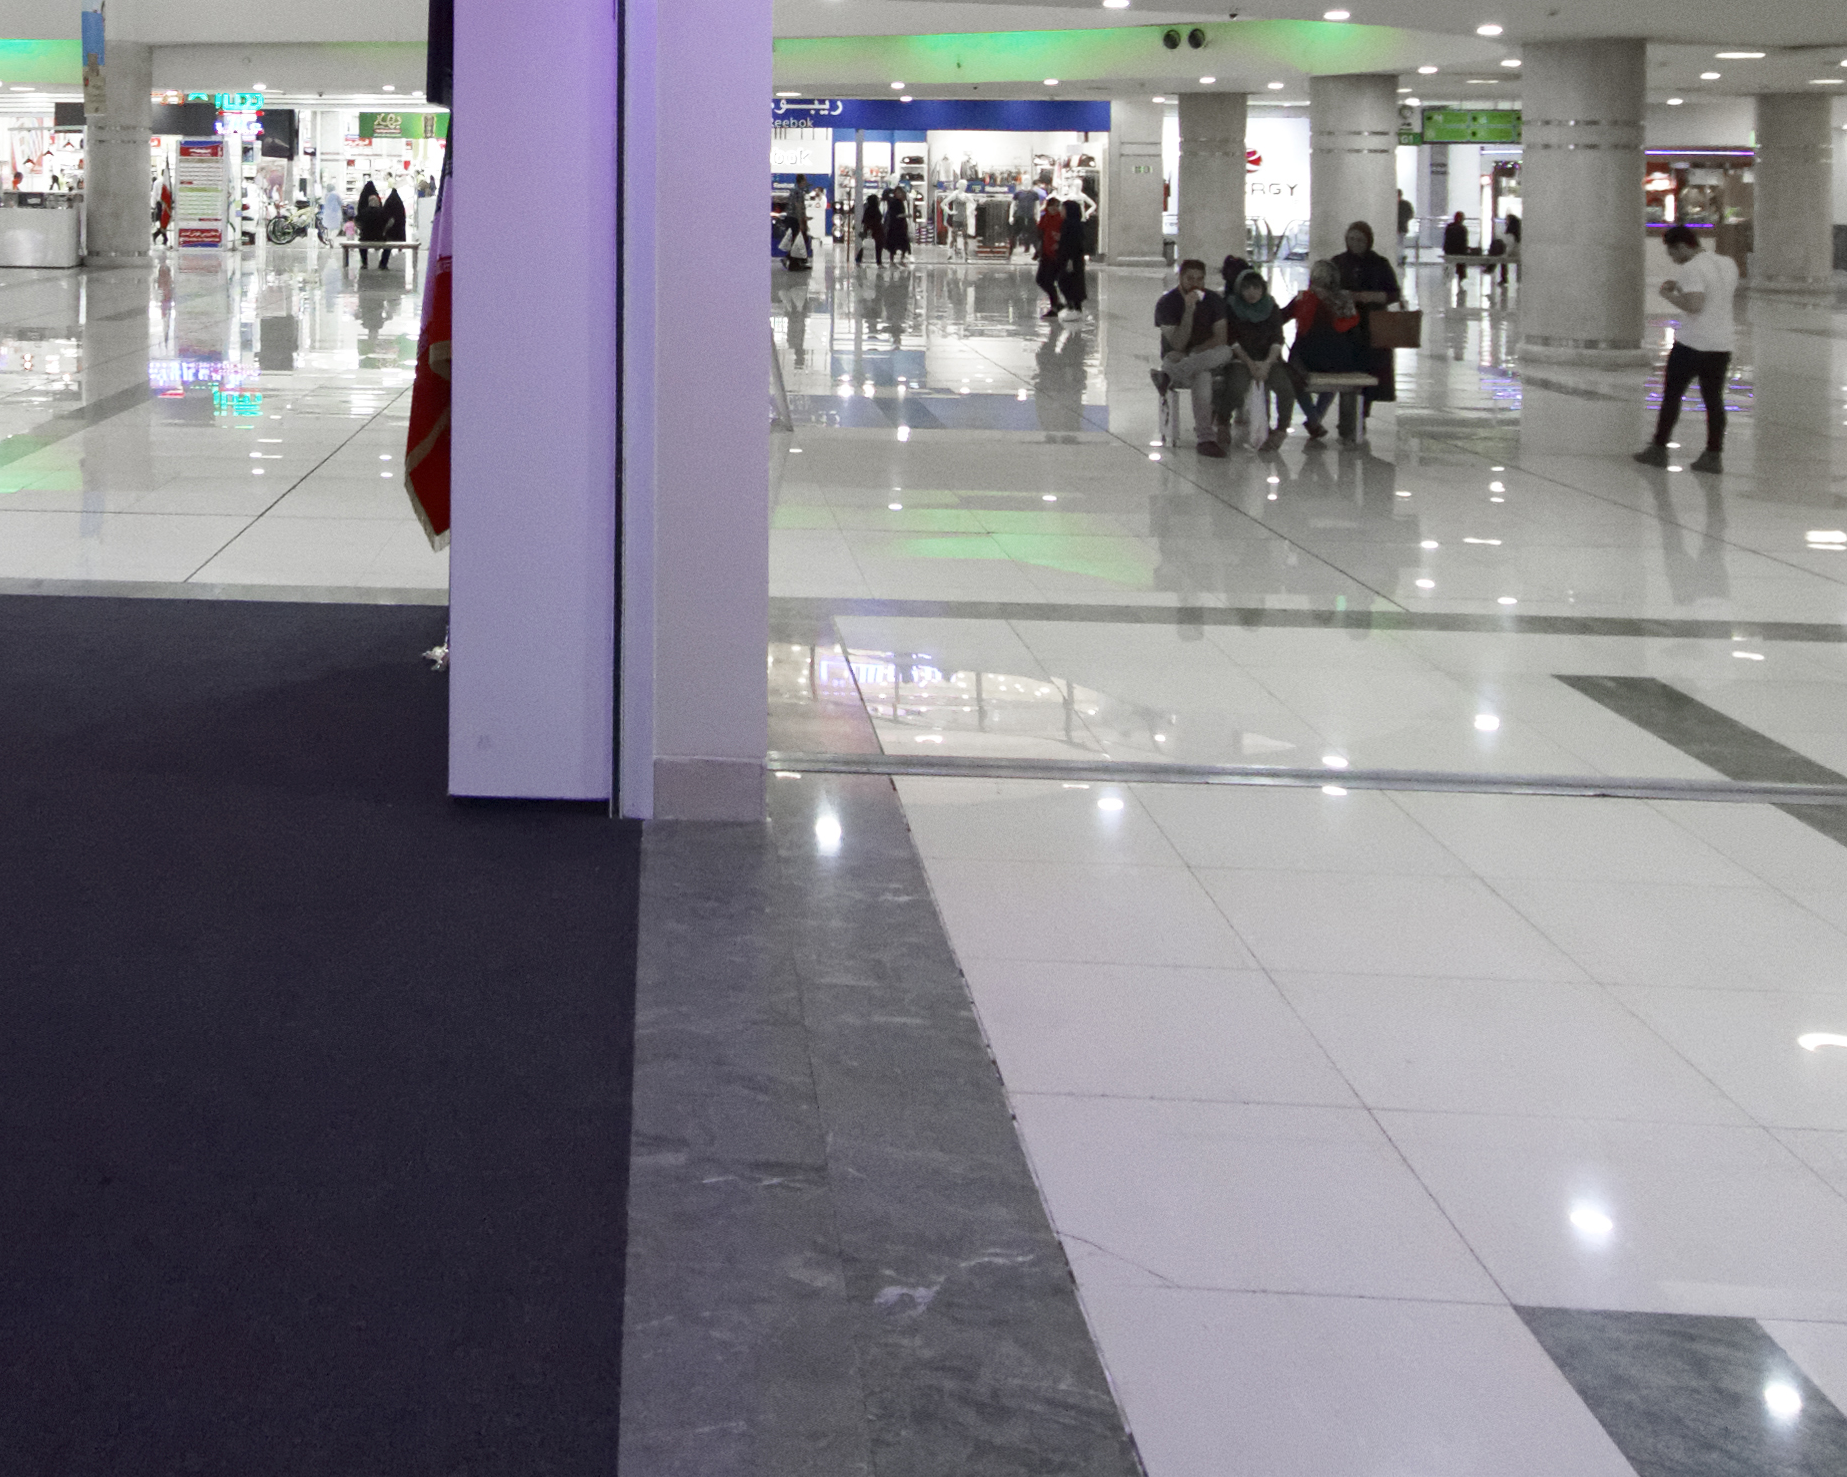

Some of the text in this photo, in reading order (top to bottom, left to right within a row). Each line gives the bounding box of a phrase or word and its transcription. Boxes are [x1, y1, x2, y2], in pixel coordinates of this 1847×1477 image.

[771, 99, 843, 116] ریبو
[771, 117, 814, 129] eebok
[1245, 182, 1298, 196] RGY
